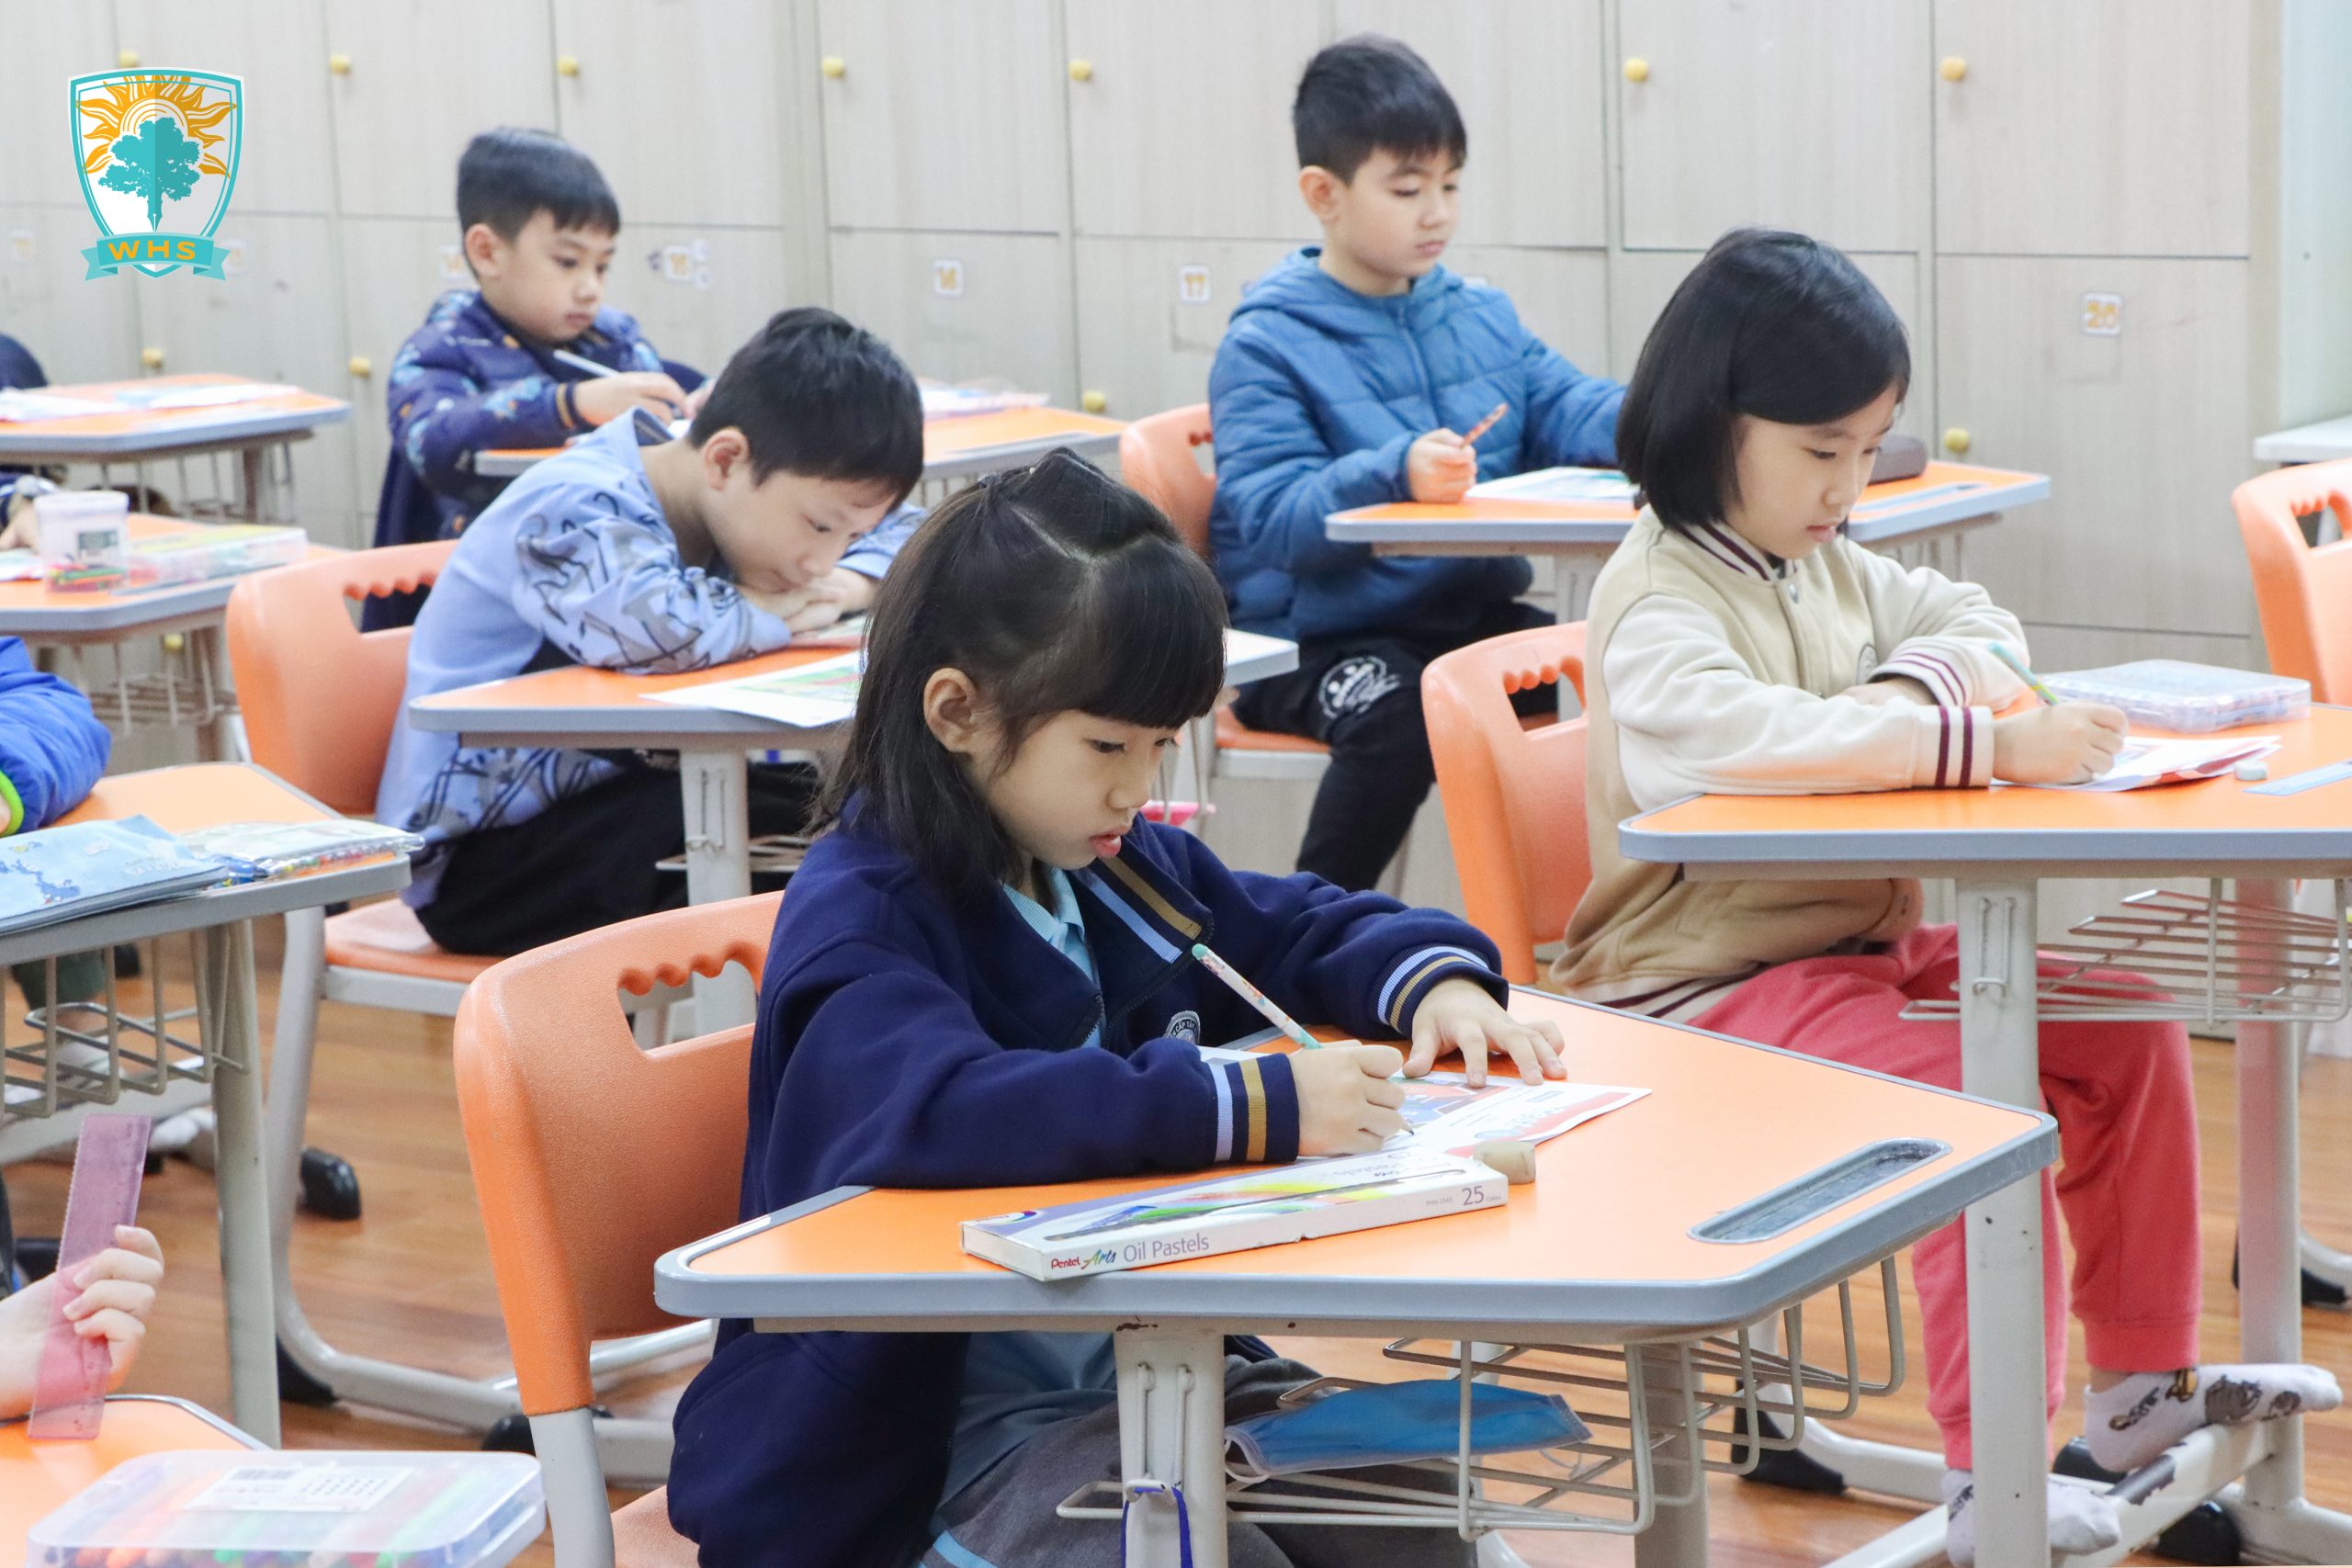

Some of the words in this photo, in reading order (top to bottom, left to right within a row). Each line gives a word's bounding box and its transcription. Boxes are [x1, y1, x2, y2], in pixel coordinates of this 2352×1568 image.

[2086, 300, 2118, 328] 20
[1462, 1185, 1485, 1206] 25
[1051, 1256, 1080, 1269] Pentel
[1081, 1248, 1117, 1269] Arts
[1124, 1241, 1147, 1263] Oil
[1152, 1232, 1210, 1258] Pastels
